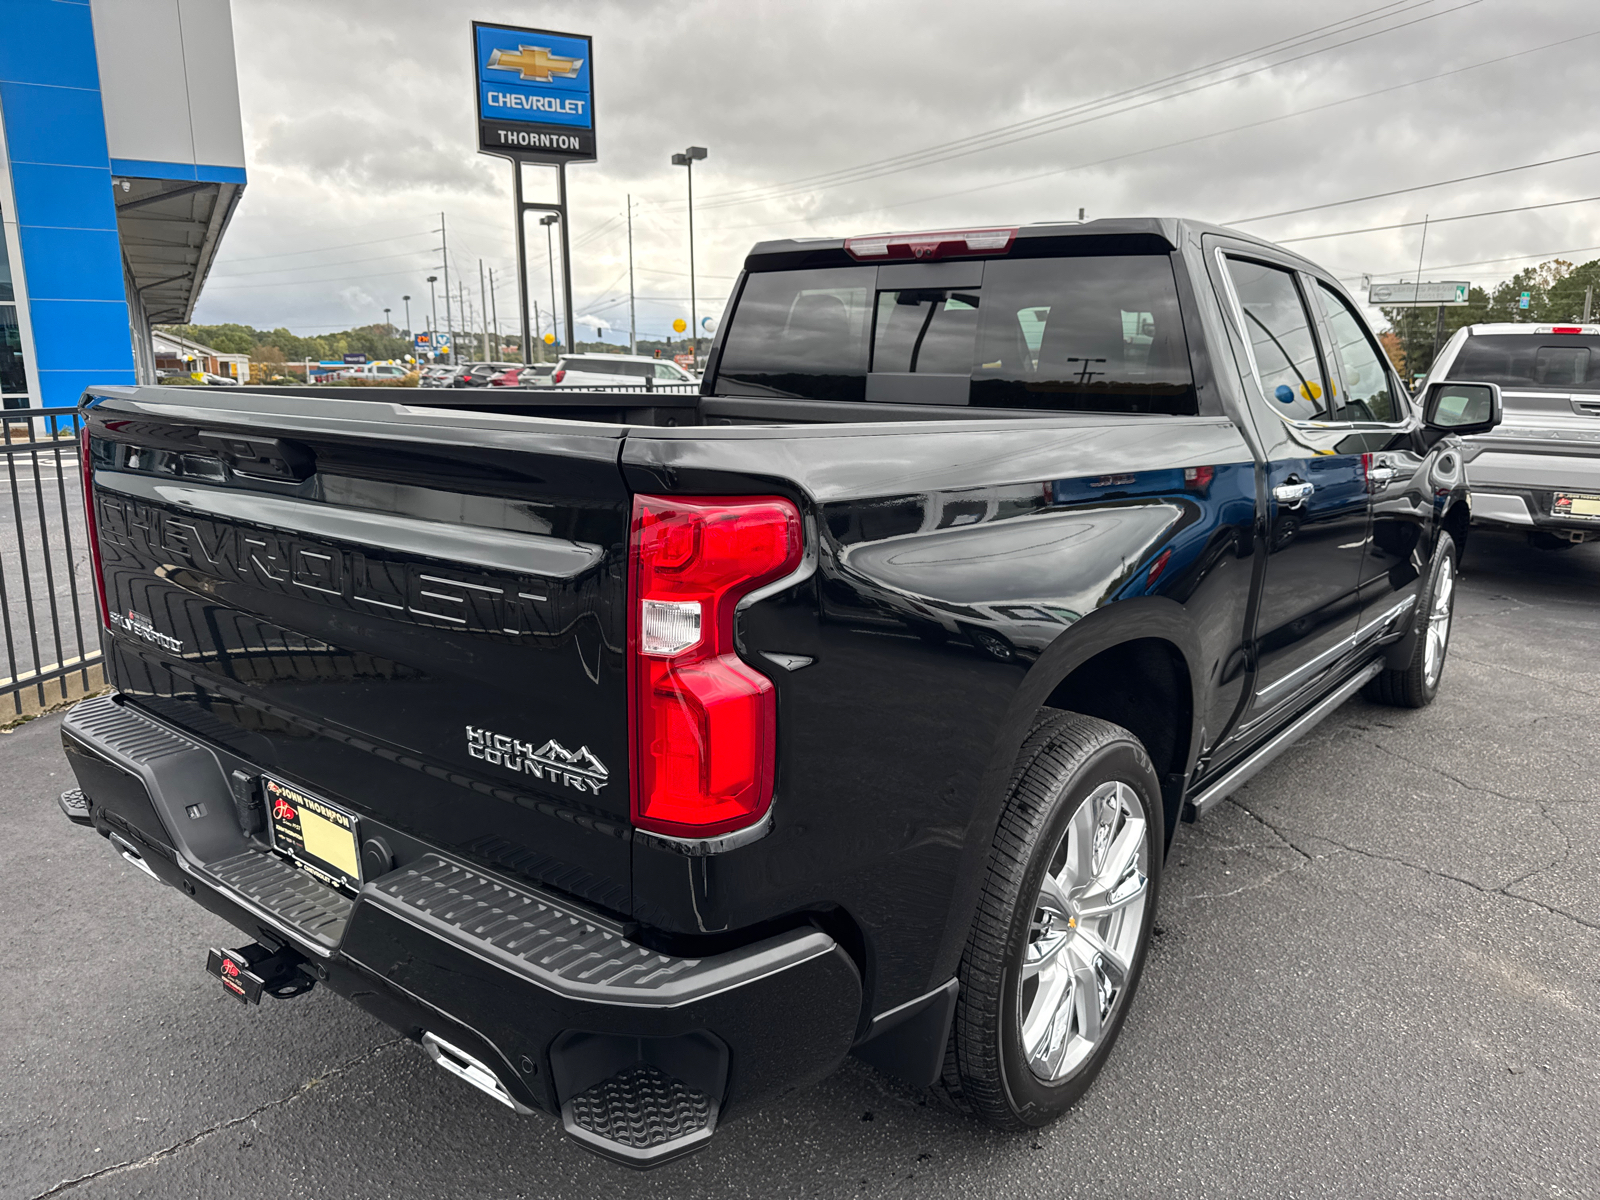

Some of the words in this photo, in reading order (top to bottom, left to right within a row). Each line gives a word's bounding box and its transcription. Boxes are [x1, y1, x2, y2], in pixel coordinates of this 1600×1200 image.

[487, 91, 586, 115] CHEVROLET
[497, 130, 580, 150] THORNTON
[98, 496, 549, 637] CHEVROLET
[465, 724, 536, 760] HIGH
[467, 741, 609, 796] COUNTRY
[281, 786, 305, 806] JOHN
